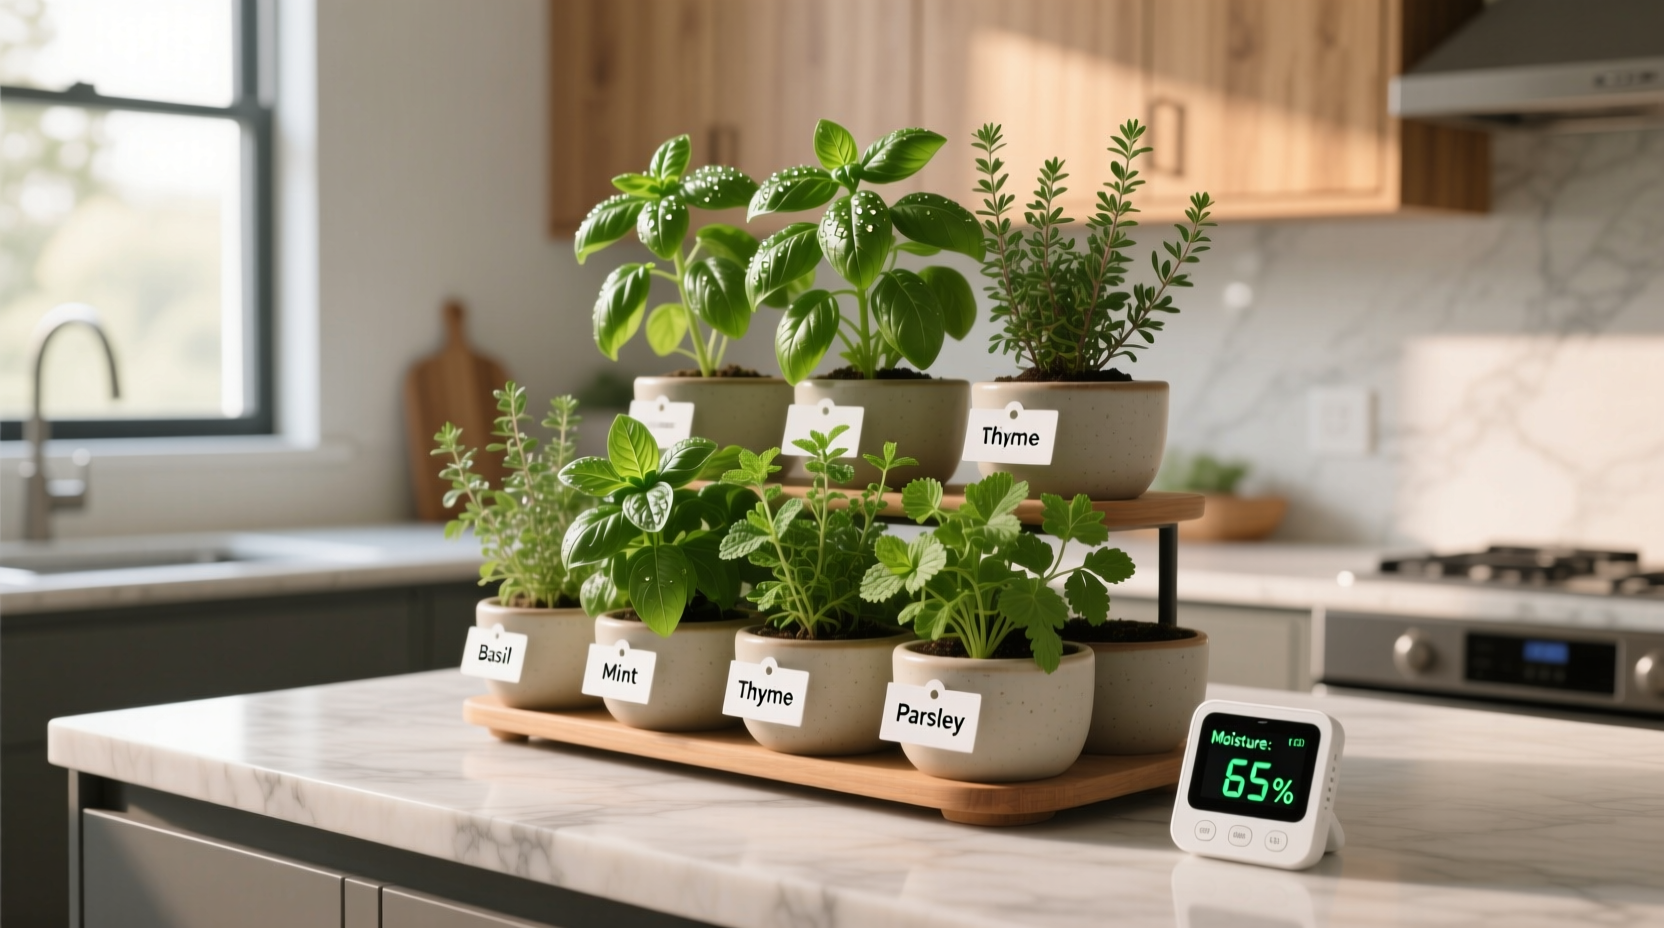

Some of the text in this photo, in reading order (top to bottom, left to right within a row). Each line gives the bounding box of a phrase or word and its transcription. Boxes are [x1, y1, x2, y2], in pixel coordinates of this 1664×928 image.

[982, 425, 1040, 448] Thyme
[478, 643, 512, 665] Basil
[602, 662, 638, 685] Mint
[738, 679, 794, 707] Thyme
[896, 703, 966, 737] Parsley
[1211, 729, 1272, 751] Moisture:
[1222, 757, 1294, 805] 65%
